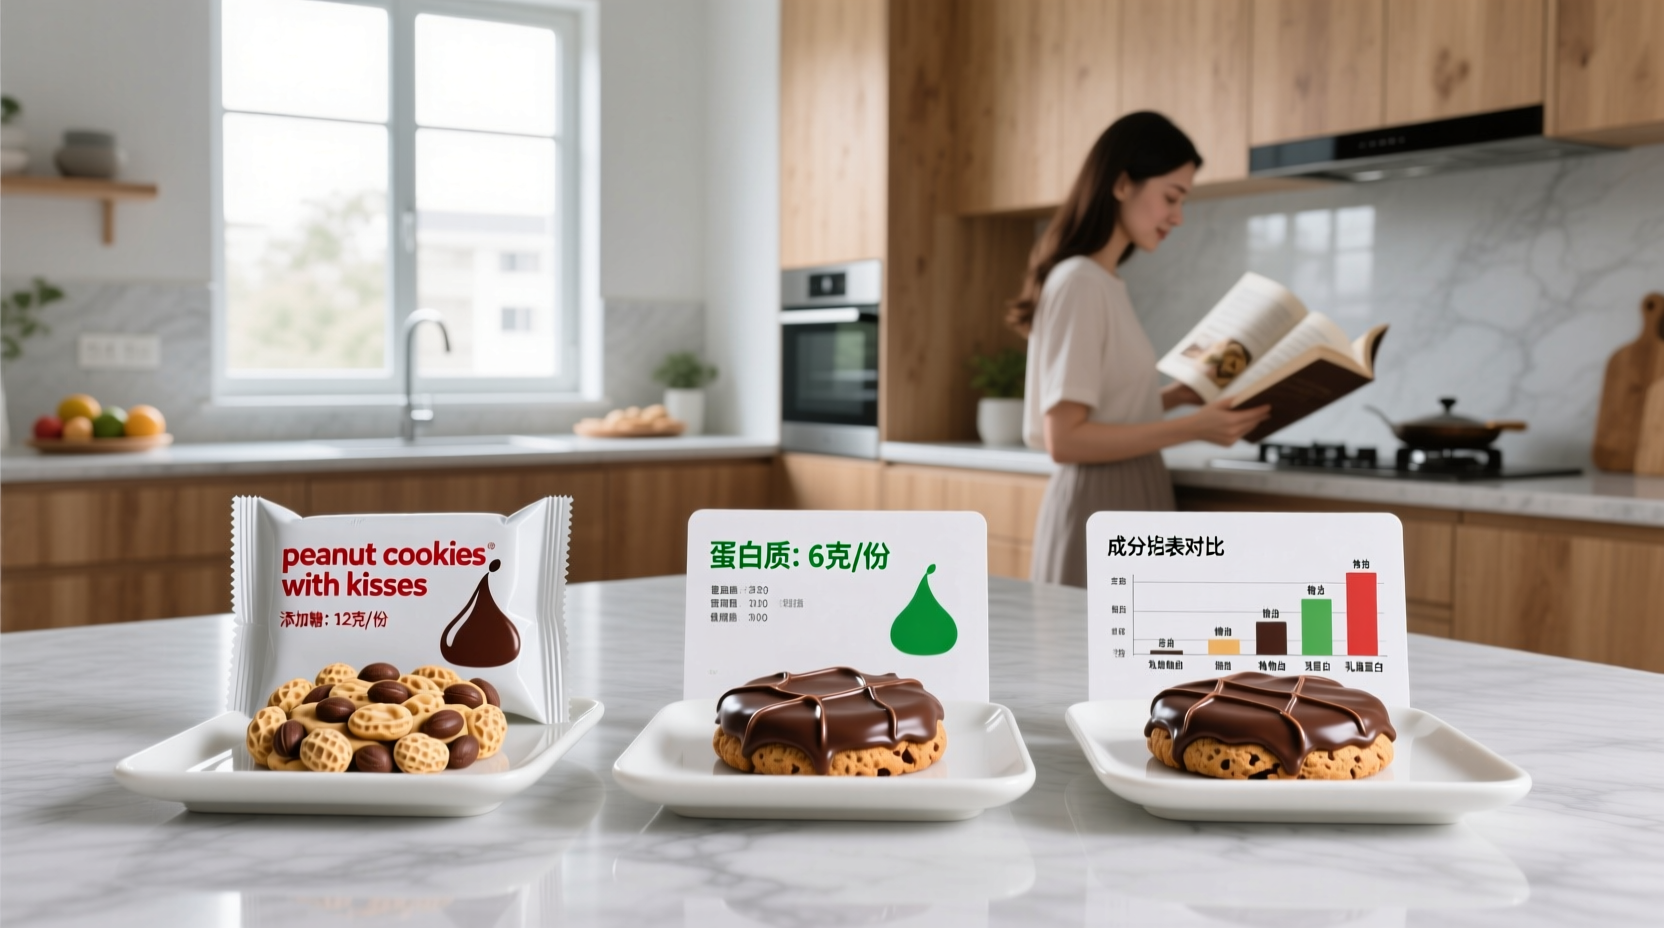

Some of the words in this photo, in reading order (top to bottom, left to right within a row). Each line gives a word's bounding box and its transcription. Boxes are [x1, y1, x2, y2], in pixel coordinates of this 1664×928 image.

[282, 542, 377, 573] peanut
[383, 540, 486, 566] cookies
[710, 540, 799, 570] 蛋白质:
[808, 540, 891, 573] 6克/份
[282, 571, 340, 597] with
[347, 570, 428, 597] kisses
[334, 610, 388, 630] 12克/份
